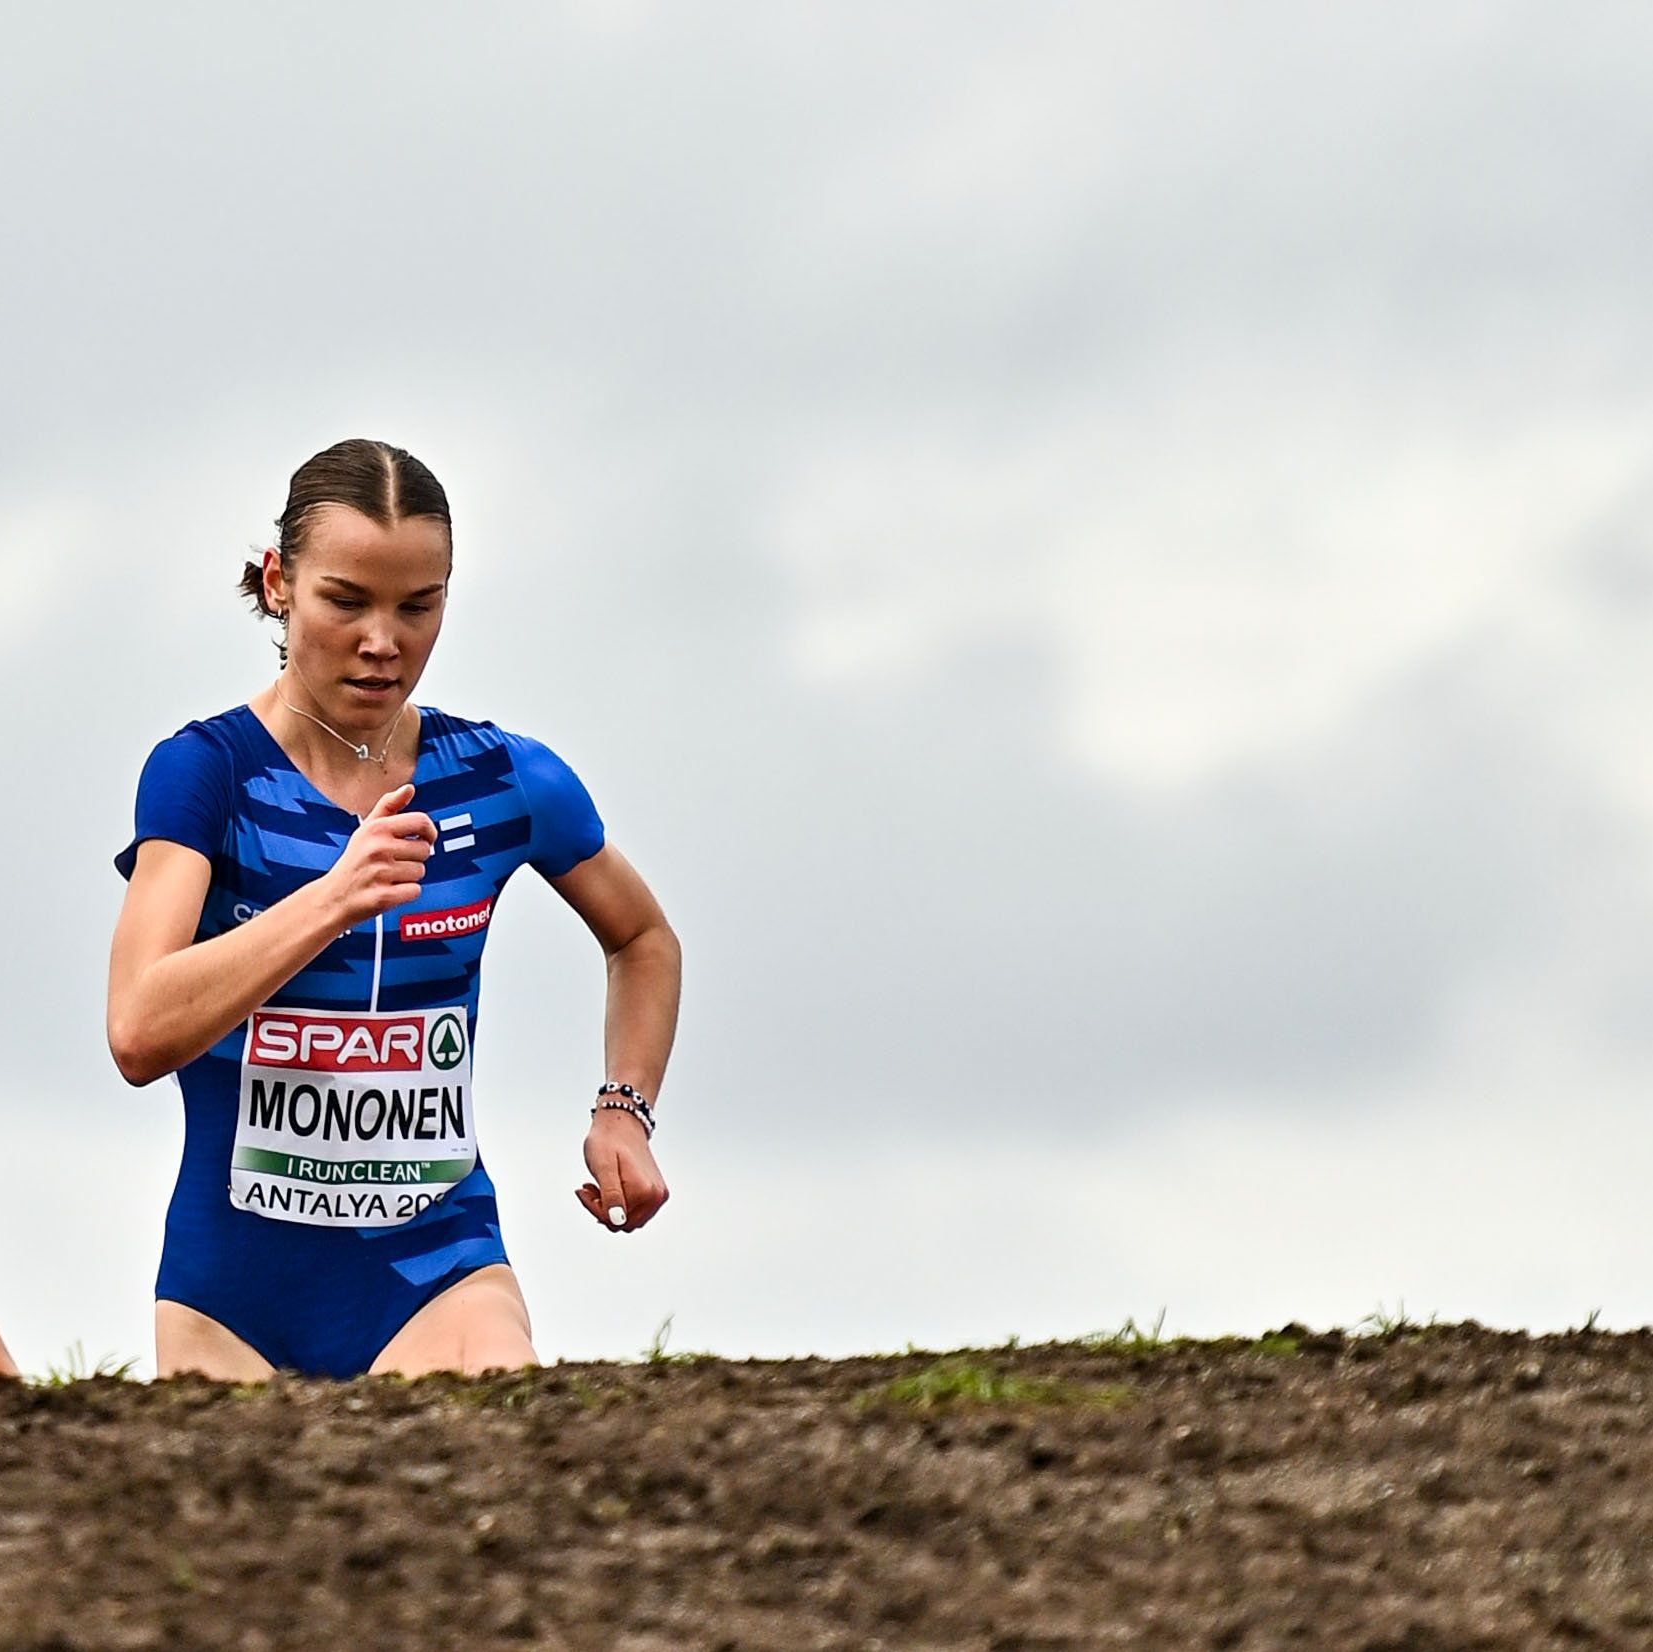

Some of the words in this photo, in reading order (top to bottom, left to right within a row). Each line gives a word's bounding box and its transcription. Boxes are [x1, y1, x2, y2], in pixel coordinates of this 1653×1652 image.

[255, 1020, 420, 1065] SPAR
[248, 1079, 466, 1142] MONONEN
[287, 1157, 294, 1176] I
[299, 1158, 347, 1181] RUN
[245, 1182, 388, 1219] ANTALYA
[396, 1192, 445, 1218] 20
